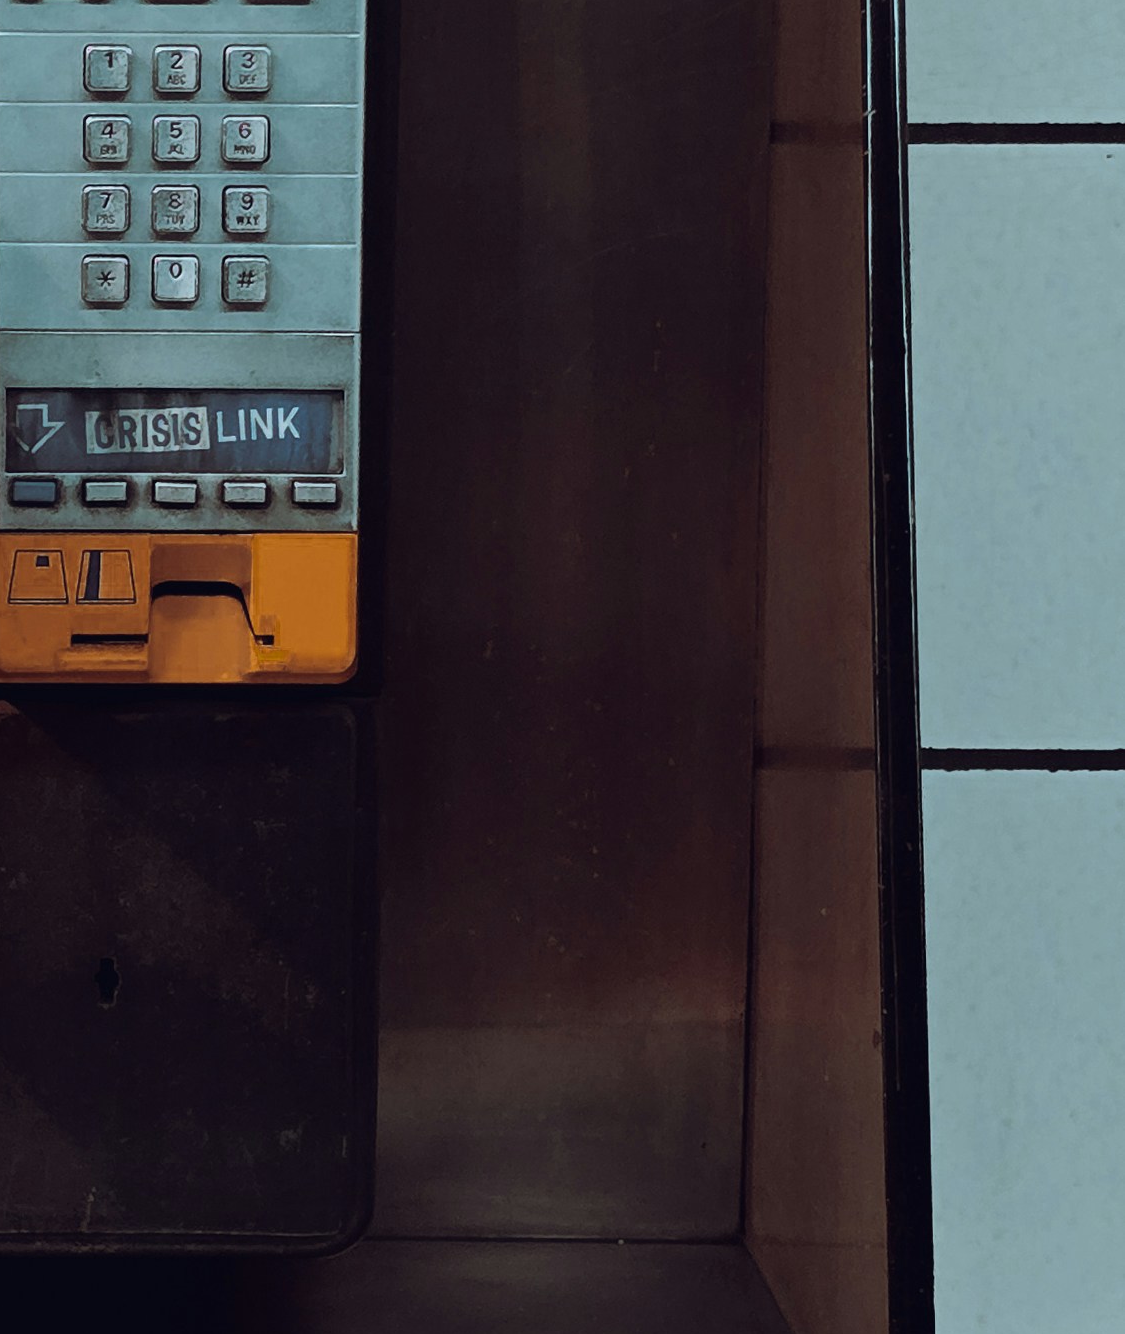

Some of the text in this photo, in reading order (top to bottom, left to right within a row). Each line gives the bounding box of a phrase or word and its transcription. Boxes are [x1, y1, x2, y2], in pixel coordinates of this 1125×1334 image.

[103, 51, 115, 69] 1
[170, 51, 184, 70] 2
[241, 51, 255, 69] 3
[166, 74, 187, 85] ABC
[239, 74, 258, 85] DEF
[101, 122, 117, 139] 4
[169, 122, 183, 139] 5
[238, 122, 252, 139] 6
[99, 192, 112, 209] 7
[168, 193, 183, 210] 8
[241, 193, 254, 210] 9
[95, 214, 116, 225] PRS
[169, 262, 183, 279] 0
[94, 405, 301, 450] CRISIS LINK
